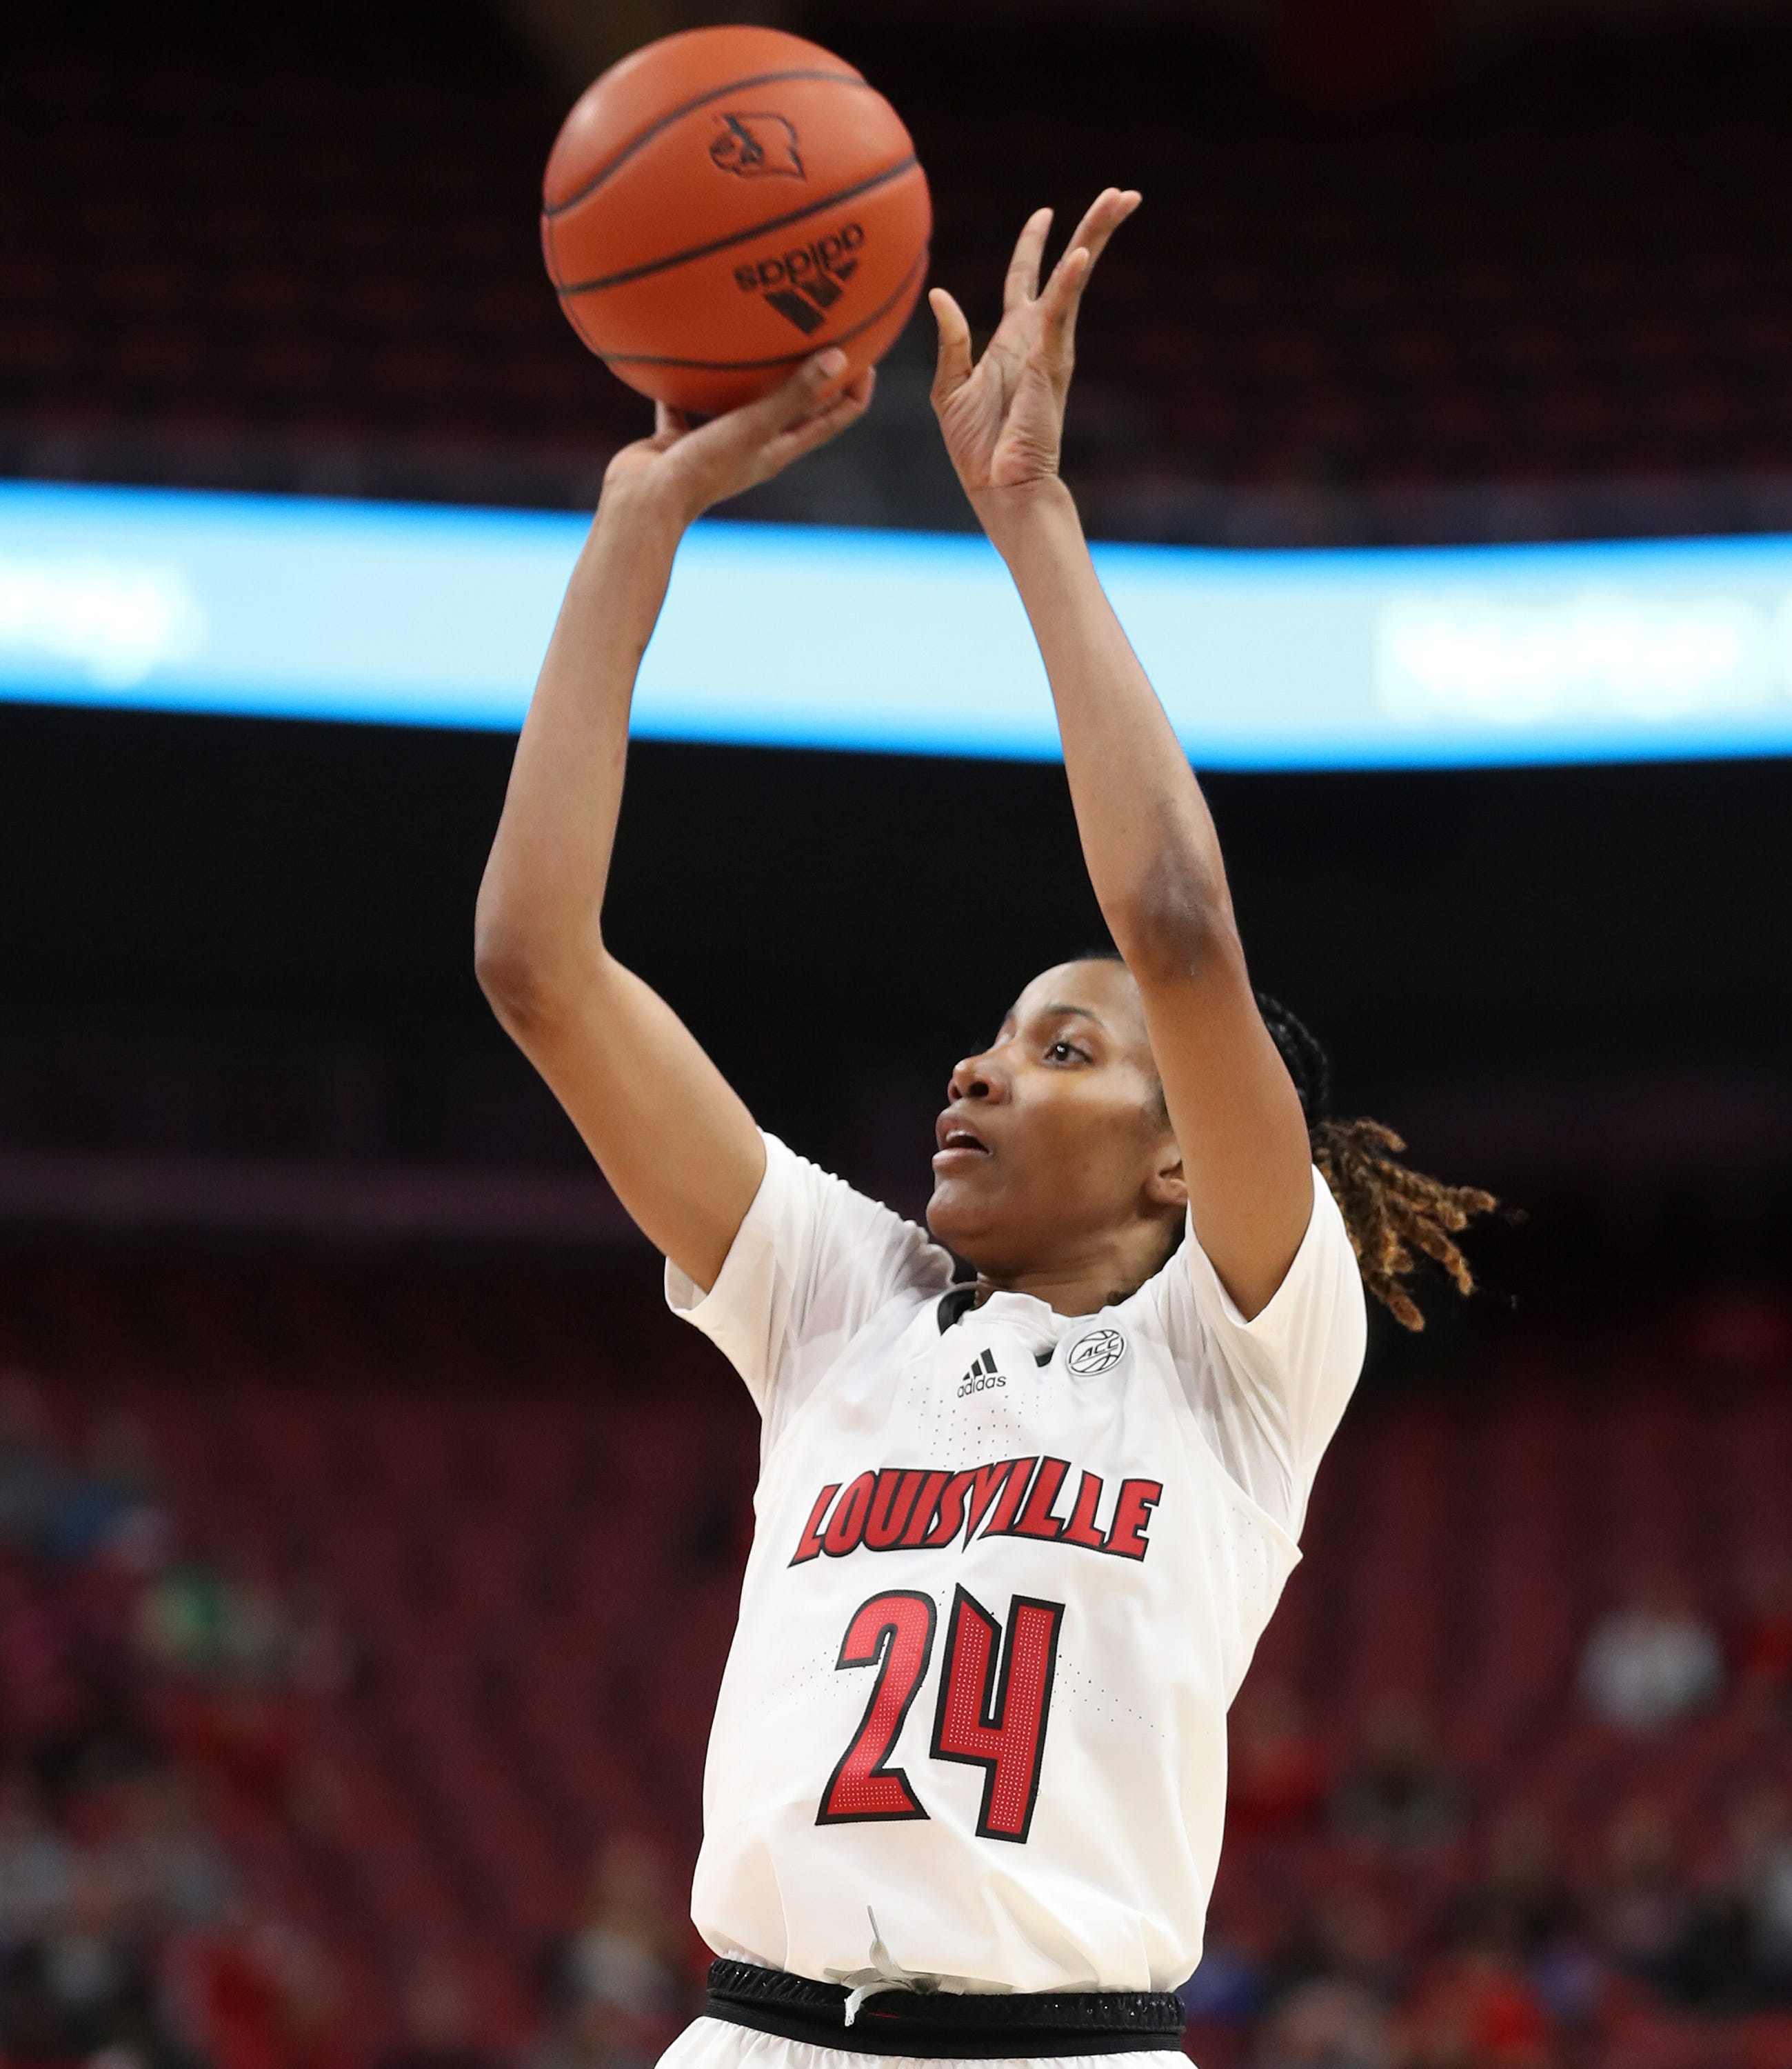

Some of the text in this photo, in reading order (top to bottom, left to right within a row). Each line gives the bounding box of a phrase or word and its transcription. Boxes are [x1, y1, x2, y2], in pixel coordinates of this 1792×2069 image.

[734, 223, 863, 292] adidas
[1078, 1337, 1120, 1358] ACC
[957, 1375, 1007, 1398] adidas
[787, 1455, 1163, 1568] LOUISVILLE
[814, 1582, 1066, 1844] 24
